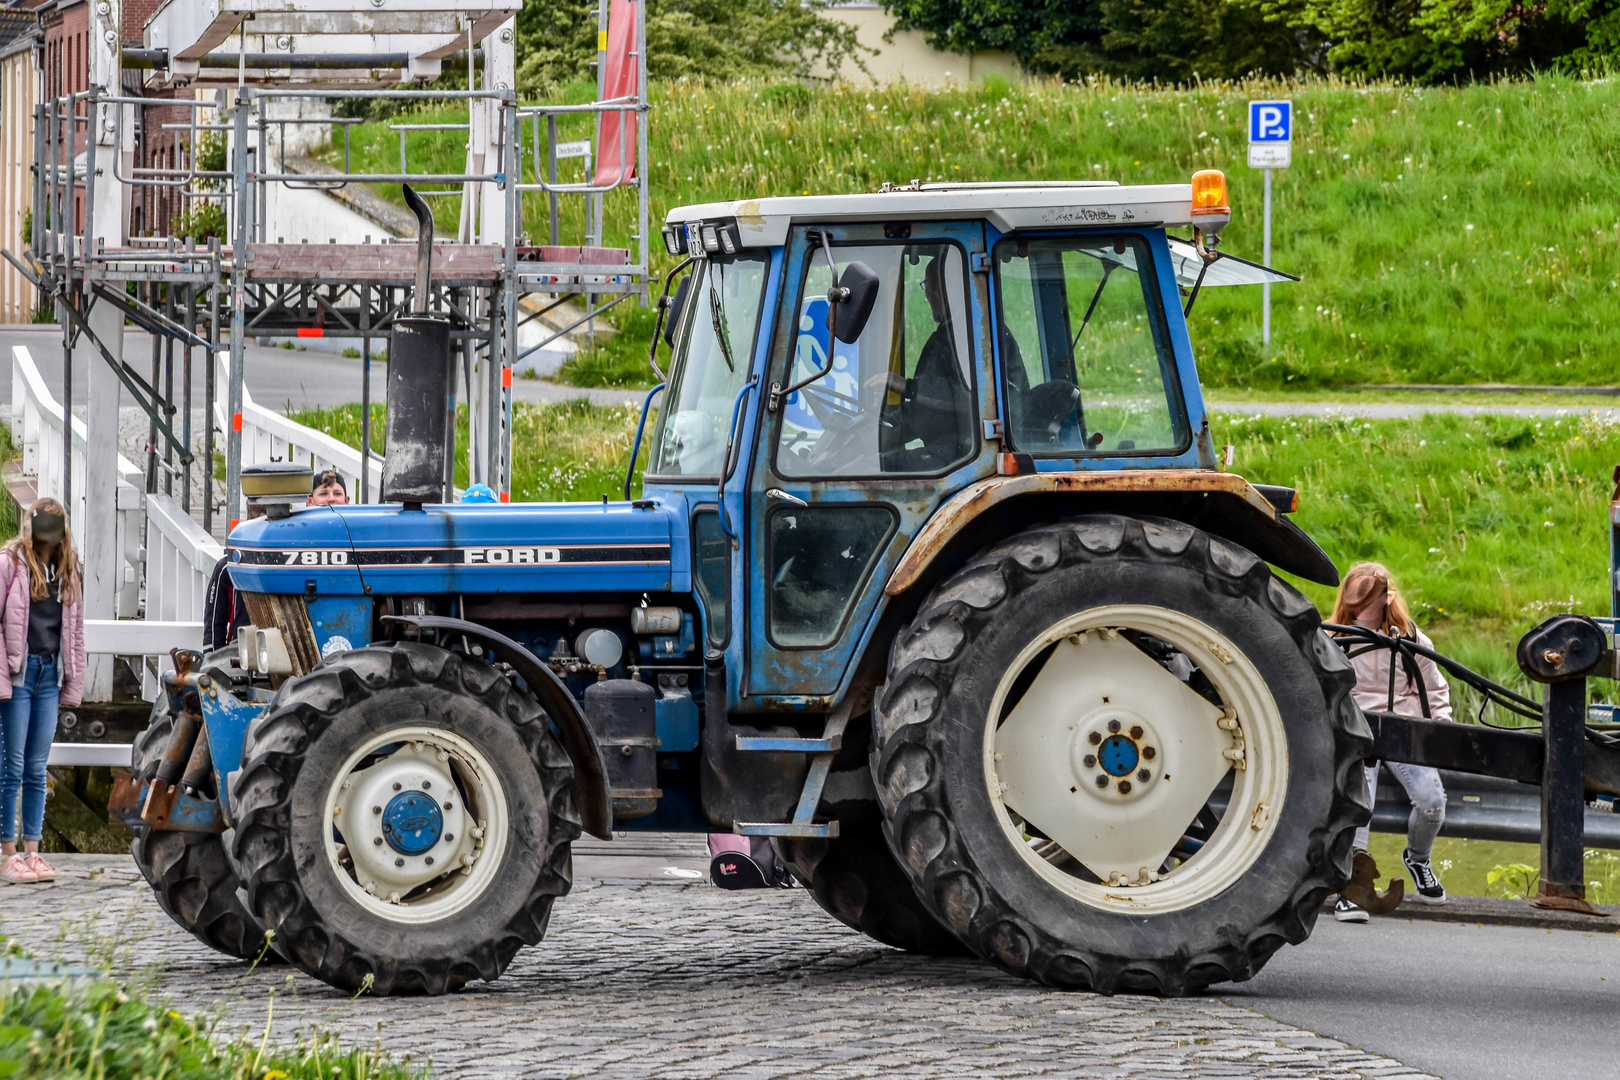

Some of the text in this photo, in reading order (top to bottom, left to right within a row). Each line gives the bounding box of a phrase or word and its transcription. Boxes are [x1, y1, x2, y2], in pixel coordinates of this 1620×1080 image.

[1259, 106, 1282, 139] P
[282, 551, 348, 565] 7810
[463, 548, 561, 564] FORD
